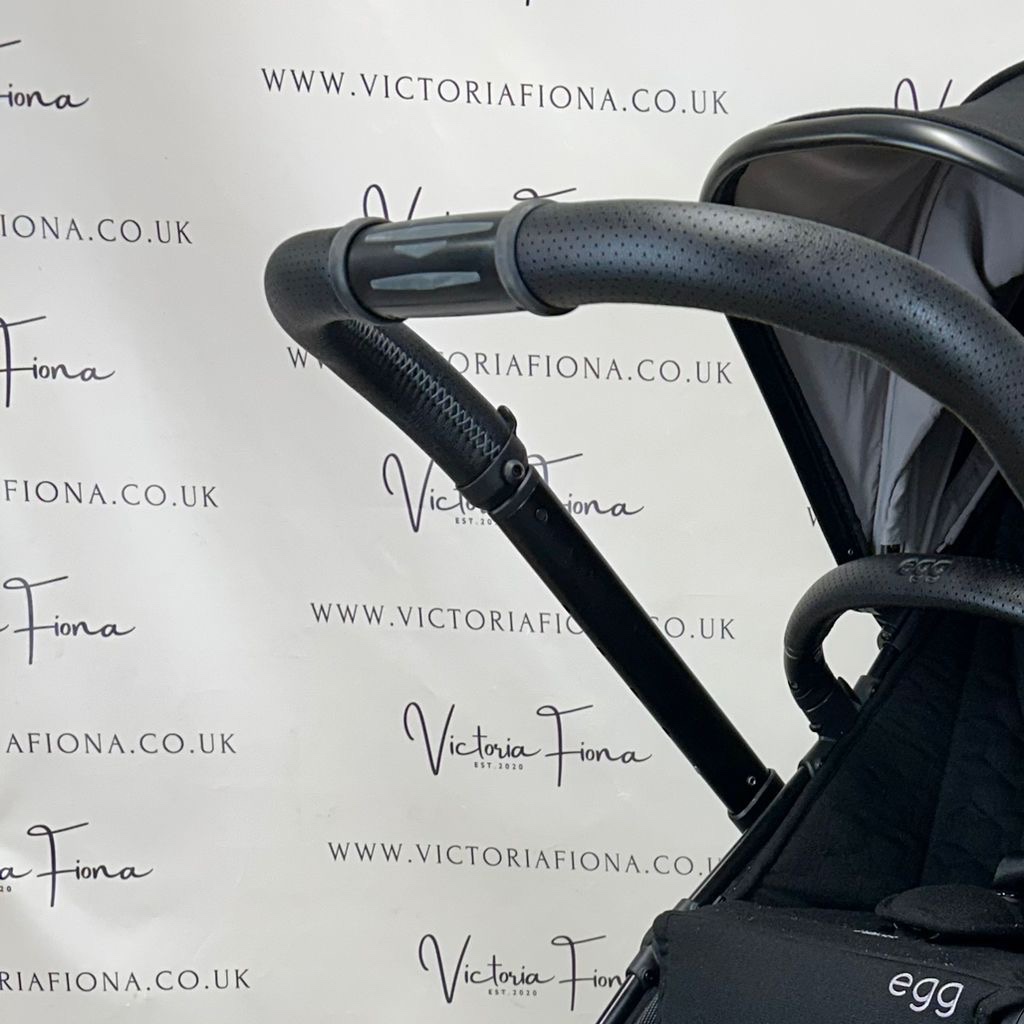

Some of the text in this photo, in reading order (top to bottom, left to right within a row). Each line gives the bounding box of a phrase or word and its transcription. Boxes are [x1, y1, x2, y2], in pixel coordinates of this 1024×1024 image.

[260, 68, 729, 115] WWW.VICTORIAFIONA.CO.UK
[0, 214, 193, 244] IONA.CO.UK
[3, 480, 219, 508] FIONA.CO.UK
[3, 576, 136, 665] Fiona
[6, 733, 237, 754] AFIONA.CO.UK
[403, 702, 653, 787] Victoria Fiona
[474, 762, 524, 770] EST.2020
[27, 822, 154, 907] Fiona
[0, 969, 250, 992] RIAFIONA.CO.UK
[418, 934, 625, 1011] Victoria Fion
[888, 972, 964, 1018] egg
